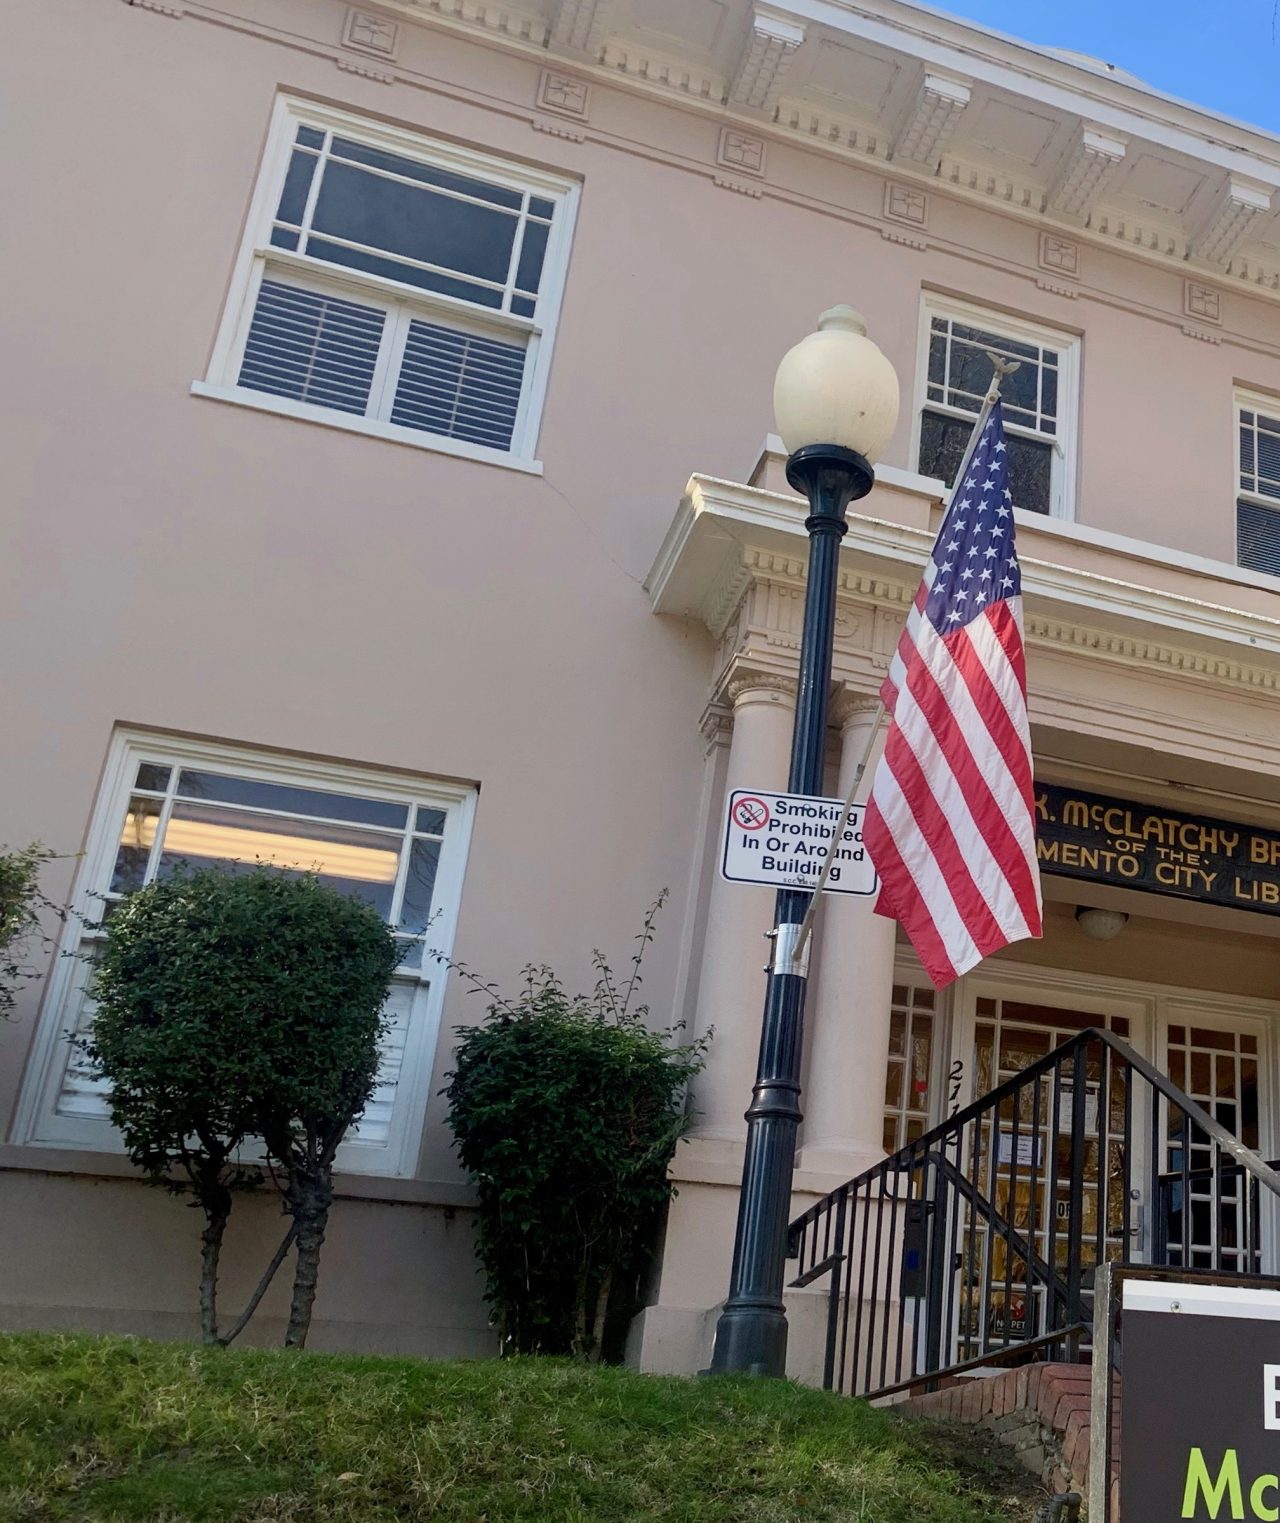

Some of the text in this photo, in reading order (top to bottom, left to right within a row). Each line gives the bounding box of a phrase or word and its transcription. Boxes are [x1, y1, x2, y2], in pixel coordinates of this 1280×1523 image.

[775, 801, 858, 826] Smoking
[768, 819, 864, 842] Prohibied
[1063, 800, 1239, 857] McCLATCHY
[742, 834, 759, 849] In
[766, 837, 790, 852] Or
[1037, 838, 1140, 878] MENTO
[1155, 862, 1218, 892] CITY
